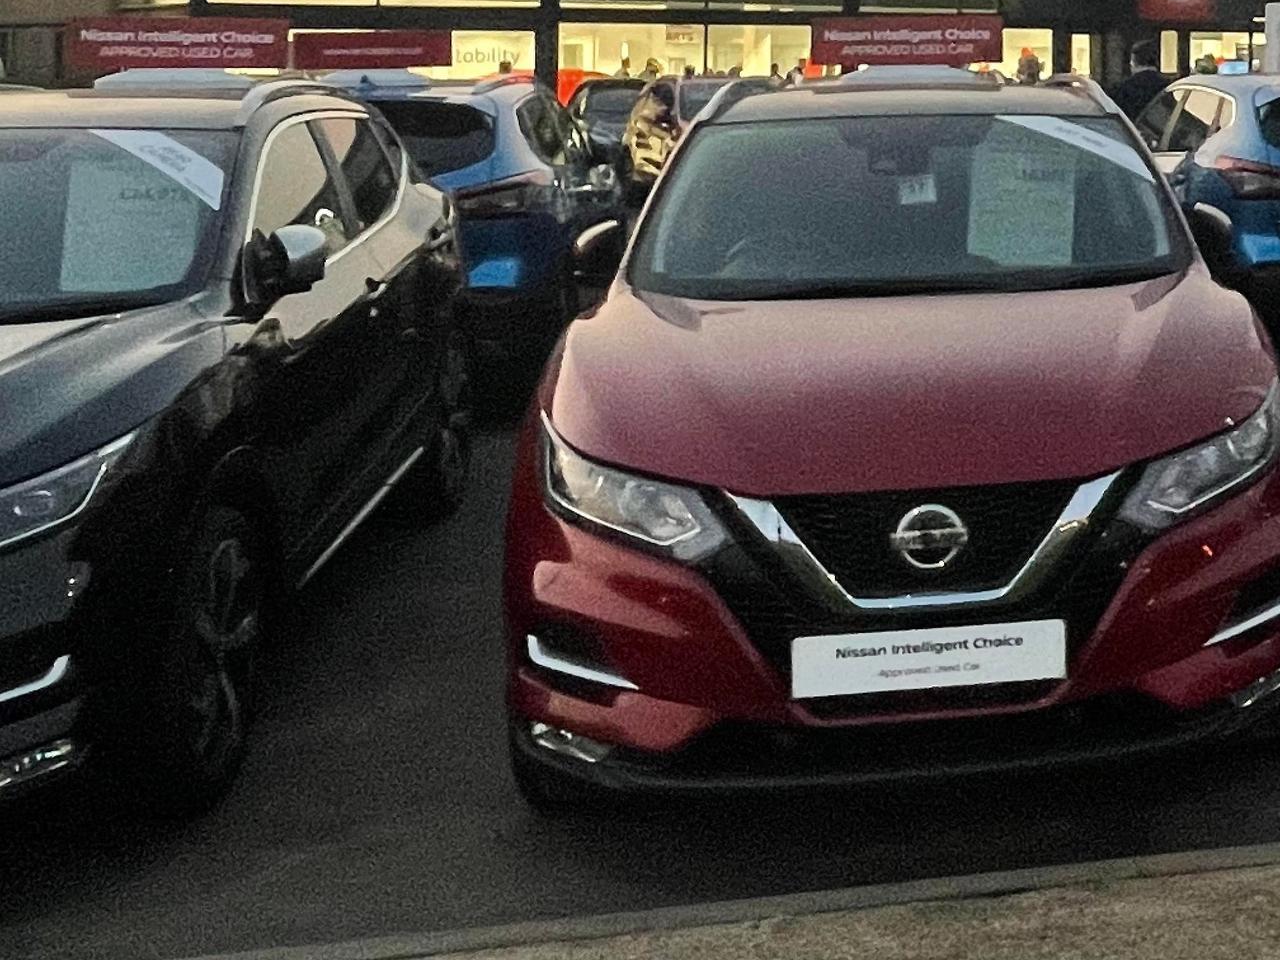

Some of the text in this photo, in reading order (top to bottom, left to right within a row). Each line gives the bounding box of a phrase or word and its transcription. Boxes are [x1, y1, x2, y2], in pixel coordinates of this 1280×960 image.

[81, 29, 275, 45] Nissan Intelligent Choice
[824, 28, 991, 43] Nissan Intelligent Choice
[99, 46, 180, 58] APPROVED
[182, 46, 220, 58] USED
[842, 43, 974, 55] APPROVED USED CAR
[835, 634, 1024, 659] Nissan Intelligent Choice
